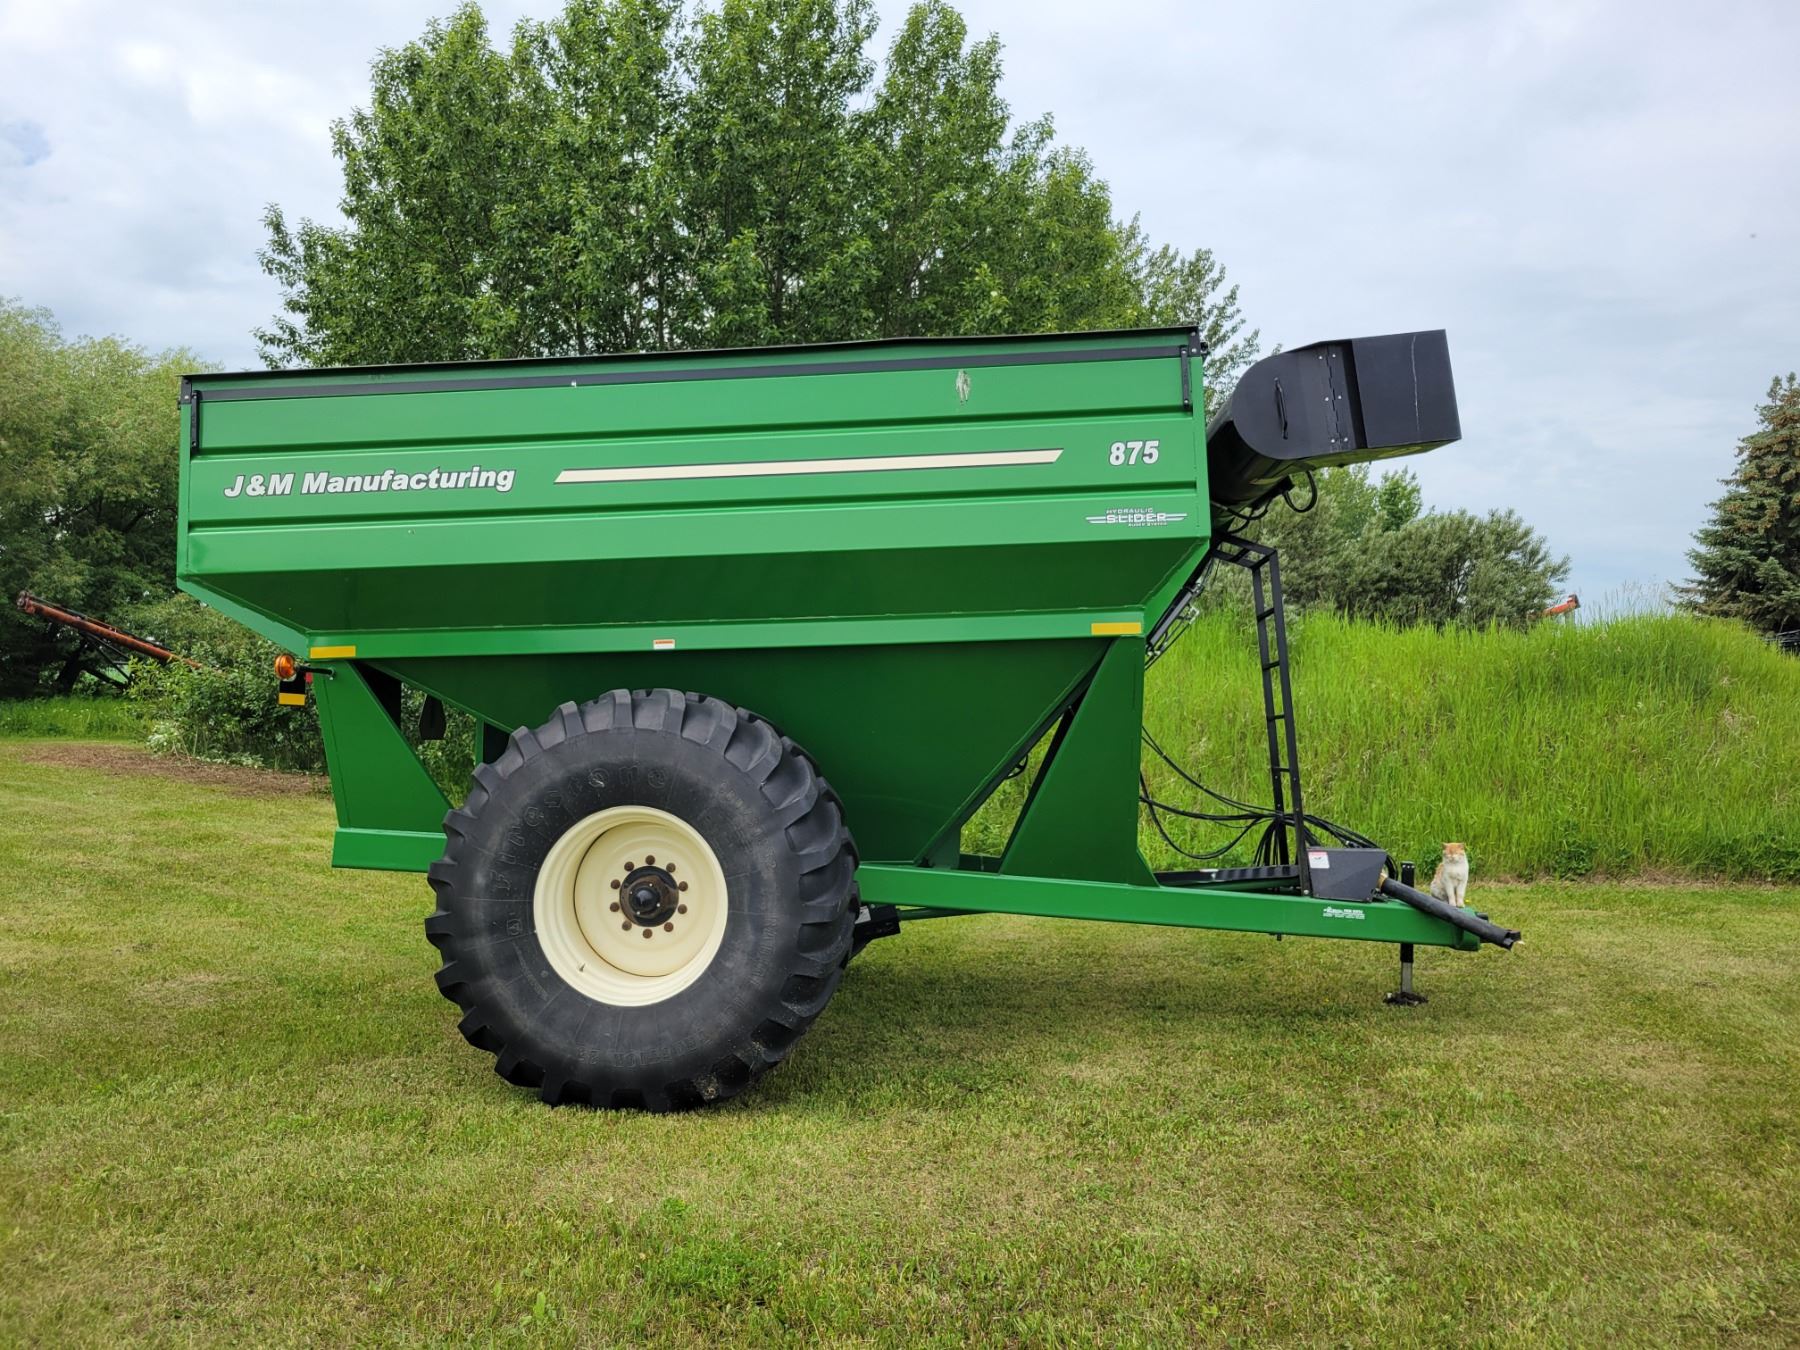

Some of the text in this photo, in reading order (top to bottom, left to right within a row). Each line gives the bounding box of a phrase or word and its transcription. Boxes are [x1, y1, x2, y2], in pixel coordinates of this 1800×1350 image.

[1109, 440, 1160, 466] 875
[224, 466, 516, 497] J&M Manufacturing
[1106, 512, 1167, 523] SLIDER
